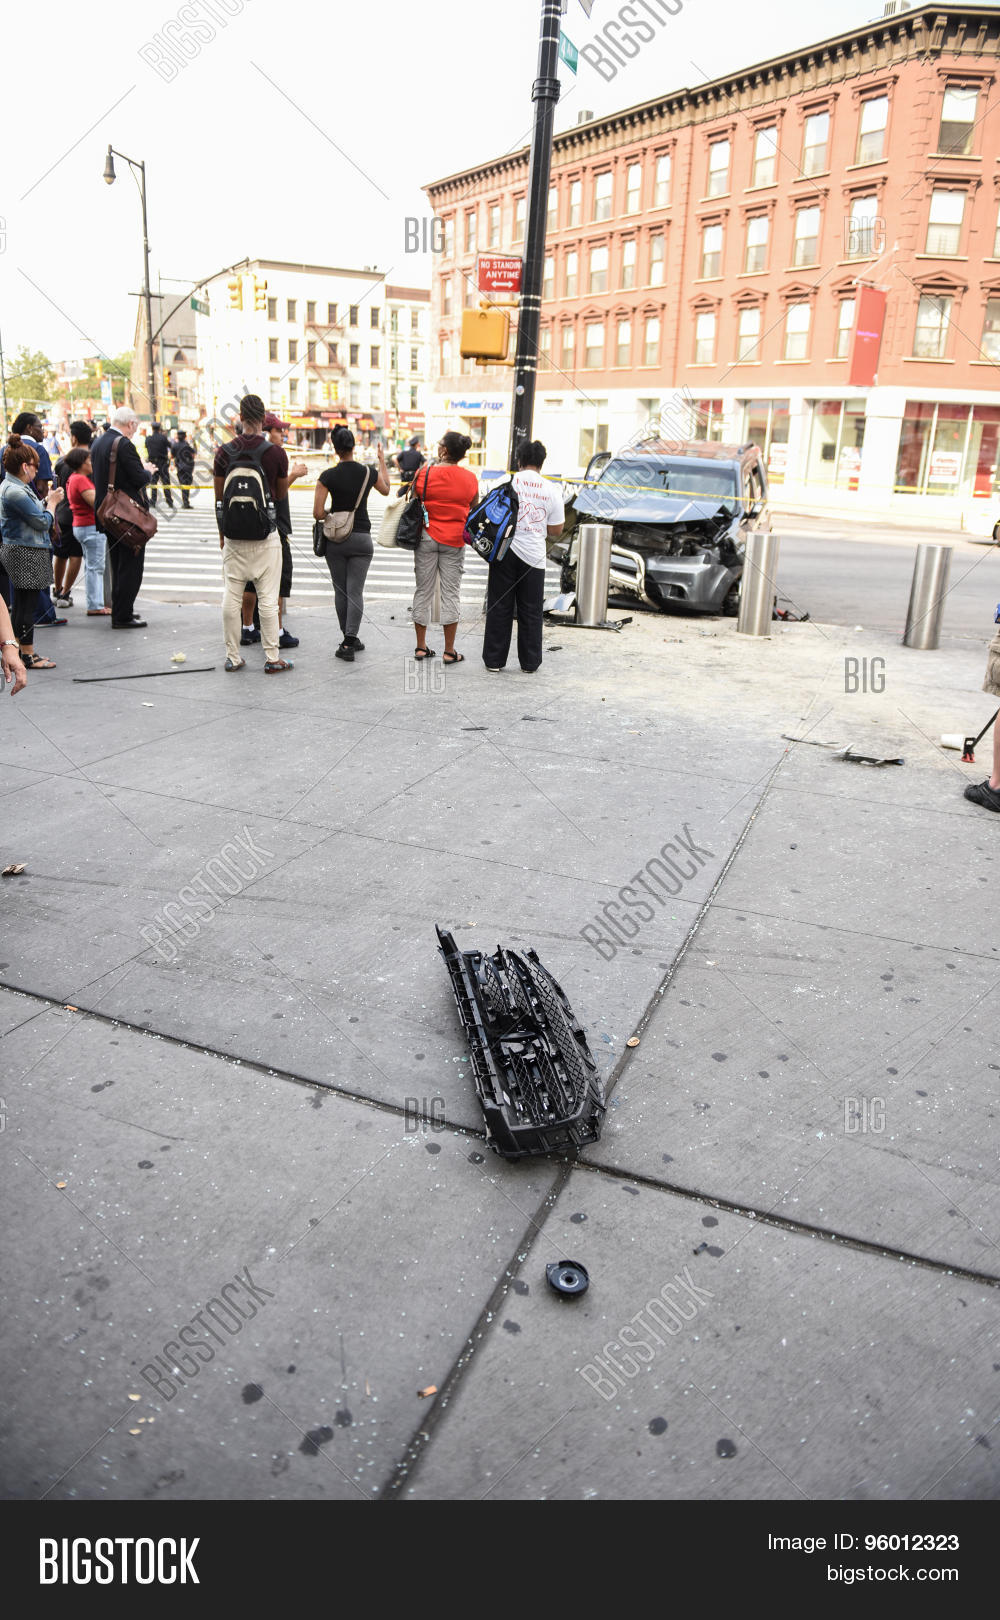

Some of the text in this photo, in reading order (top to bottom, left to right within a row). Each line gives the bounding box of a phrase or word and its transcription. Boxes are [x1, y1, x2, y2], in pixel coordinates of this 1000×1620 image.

[480, 260, 522, 270] NO STANDIN
[486, 270, 520, 279] ANYTIME
[523, 481, 543, 489] want
